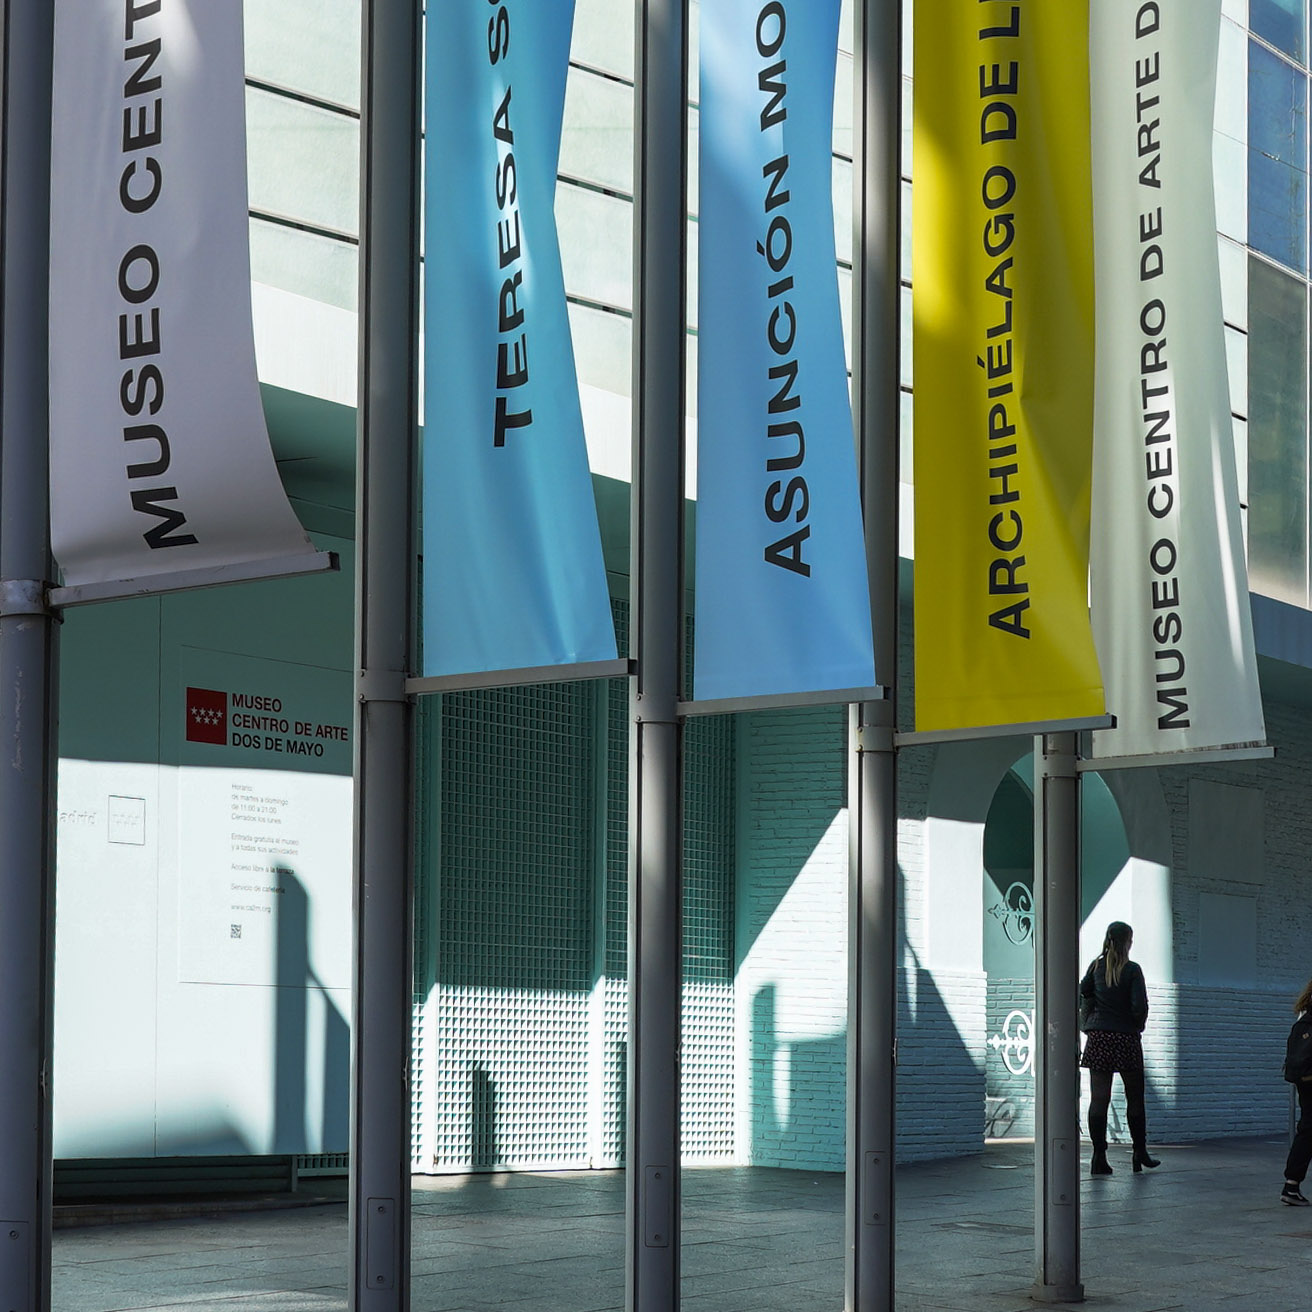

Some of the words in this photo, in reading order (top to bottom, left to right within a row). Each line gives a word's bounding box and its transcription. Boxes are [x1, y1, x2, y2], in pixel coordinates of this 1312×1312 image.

[978, 59, 1021, 146] DE
[1134, 50, 1163, 190] ARTE
[492, 85, 534, 449] TERESA
[1138, 206, 1165, 283] DE
[118, 243, 201, 550] MUSEO
[755, 153, 812, 579] ASUNCIÓN
[976, 164, 1032, 641] ARCHIPIÉLAGO
[1138, 297, 1175, 520] CENTRO
[232, 692, 282, 713] MUSEO
[1148, 537, 1192, 732] MUSEO
[232, 713, 289, 733] CENTRO
[294, 721, 313, 736] DE
[315, 724, 349, 741] ARTE
[232, 732, 261, 749] DOS
[265, 737, 283, 752] DE
[286, 739, 324, 757] MAYO
